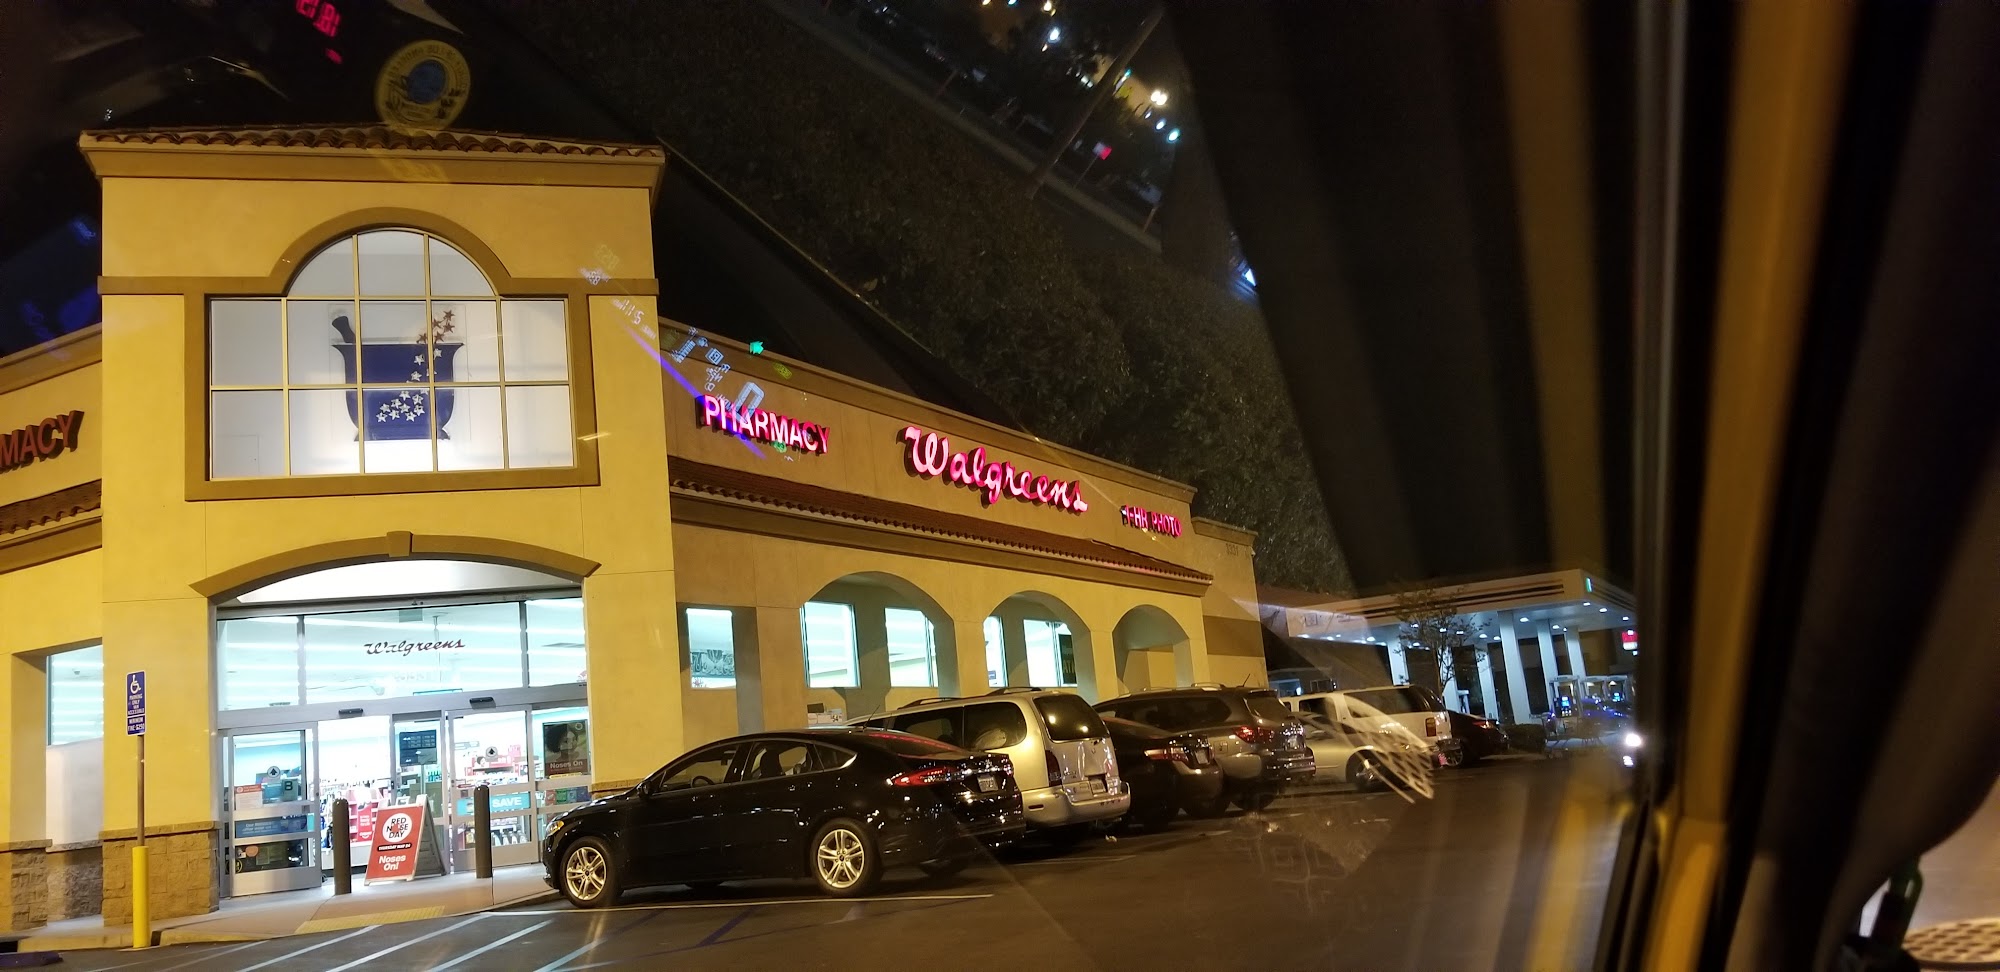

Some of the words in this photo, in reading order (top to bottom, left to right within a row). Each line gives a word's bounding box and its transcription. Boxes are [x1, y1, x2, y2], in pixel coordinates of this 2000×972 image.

[702, 394, 831, 455] PHARMACY
[904, 425, 1089, 513] Walgreens
[1151, 511, 1182, 537] PHOTO
[364, 639, 466, 656] Walgreens
[492, 797, 522, 807] SAVE
[379, 855, 407, 864] Noses
[383, 863, 399, 871] On!
